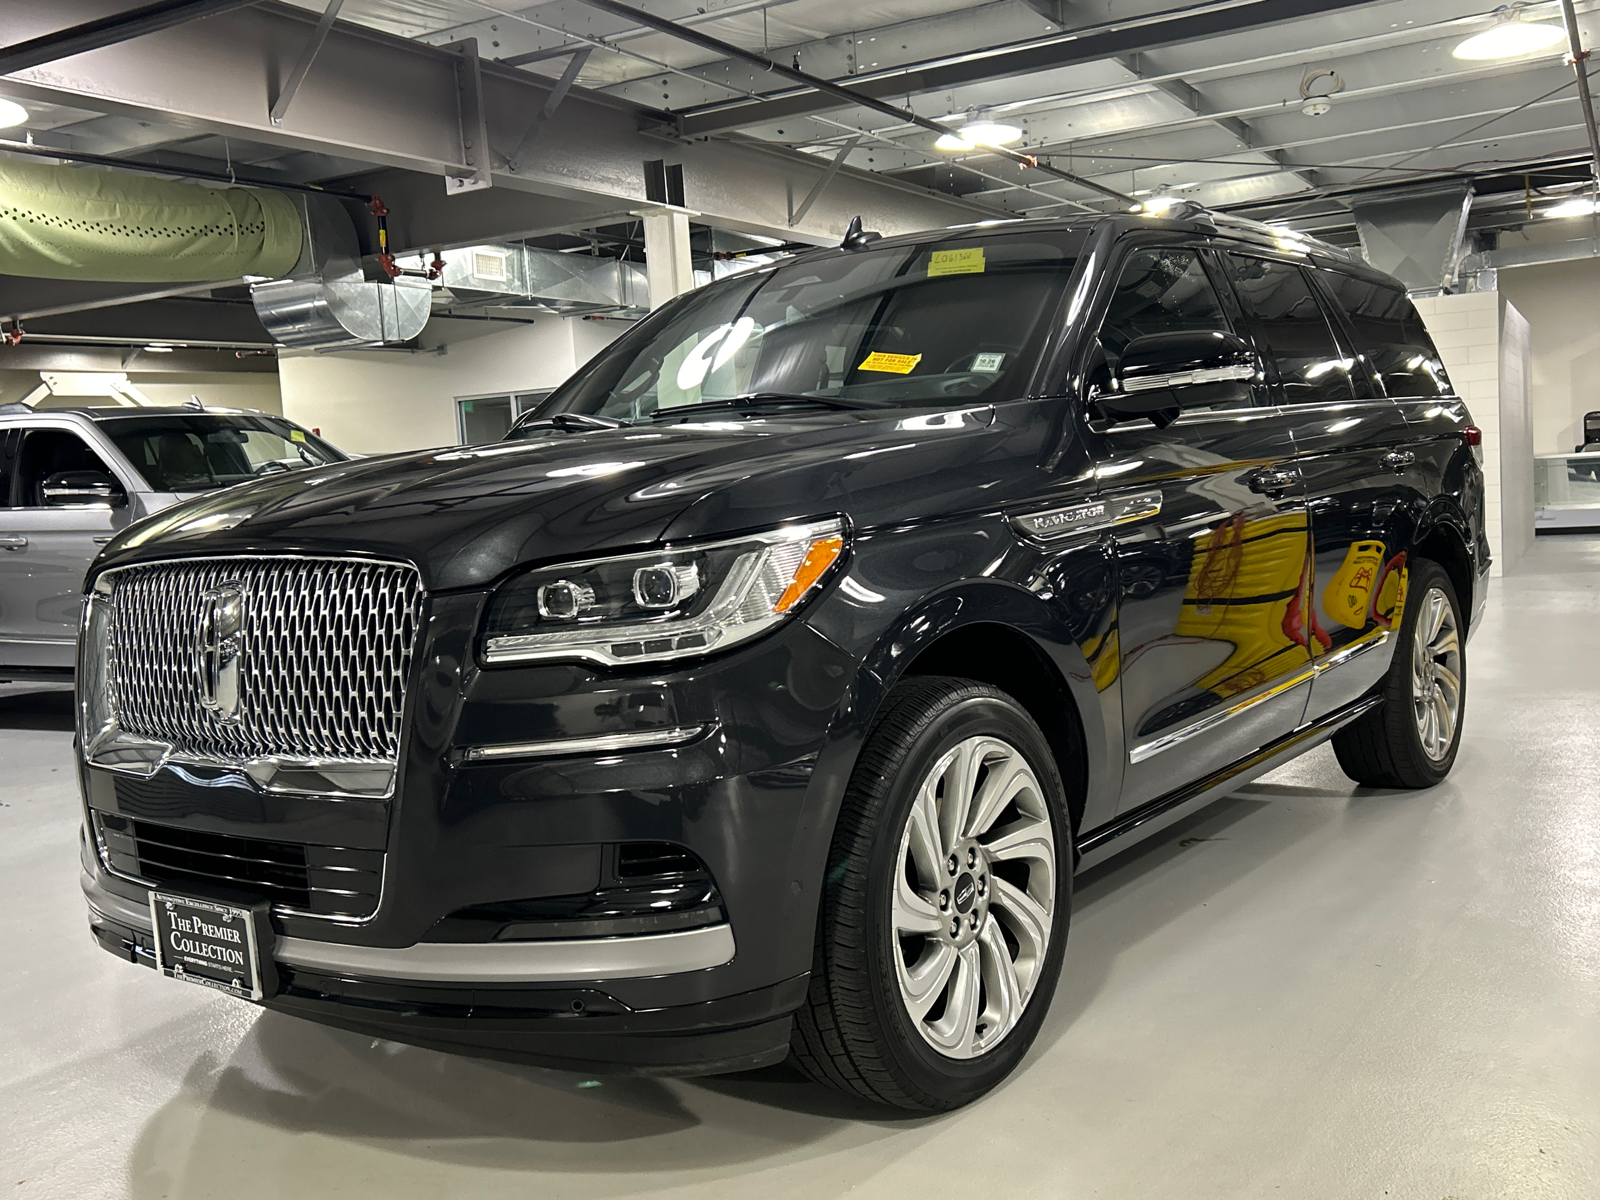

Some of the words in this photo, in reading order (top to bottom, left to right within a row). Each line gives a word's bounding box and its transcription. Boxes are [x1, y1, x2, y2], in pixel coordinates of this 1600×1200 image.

[1033, 505, 1105, 528] NAVIGATOR
[167, 911, 193, 933] THE
[192, 916, 241, 943] PREMIER
[170, 931, 244, 965] COLLECTION
